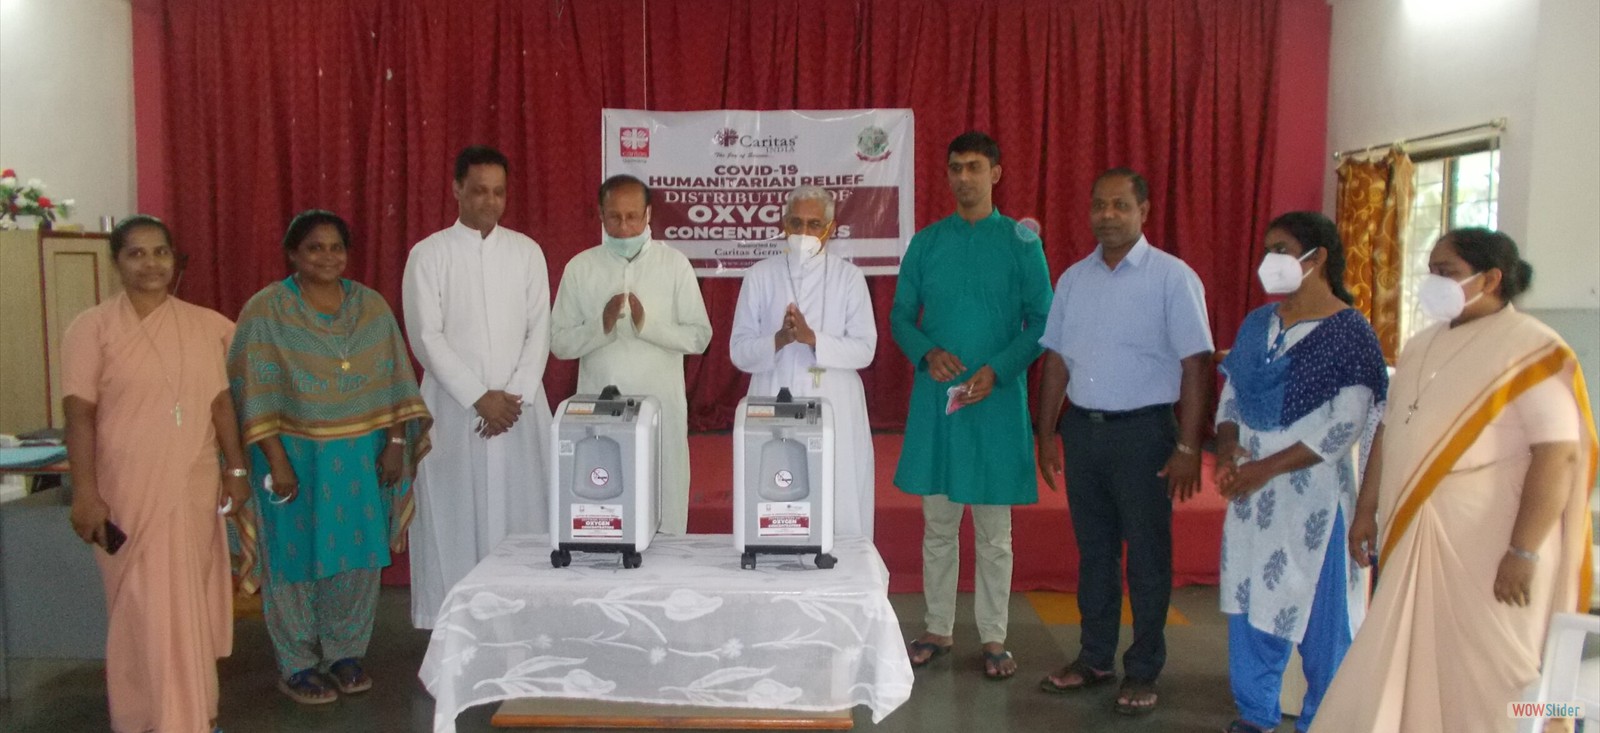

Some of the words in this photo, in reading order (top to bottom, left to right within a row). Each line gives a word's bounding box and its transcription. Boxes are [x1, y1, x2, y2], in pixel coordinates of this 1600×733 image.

[740, 135, 796, 148] Caritas
[715, 165, 798, 176] COVID-19
[649, 176, 796, 188] HUMANITARIAN
[801, 174, 865, 187] RELIEF
[664, 190, 790, 204] DISTRIBUTI
[688, 204, 786, 224] OXYG
[714, 248, 750, 256] Caritas
[753, 248, 782, 256] Germ
